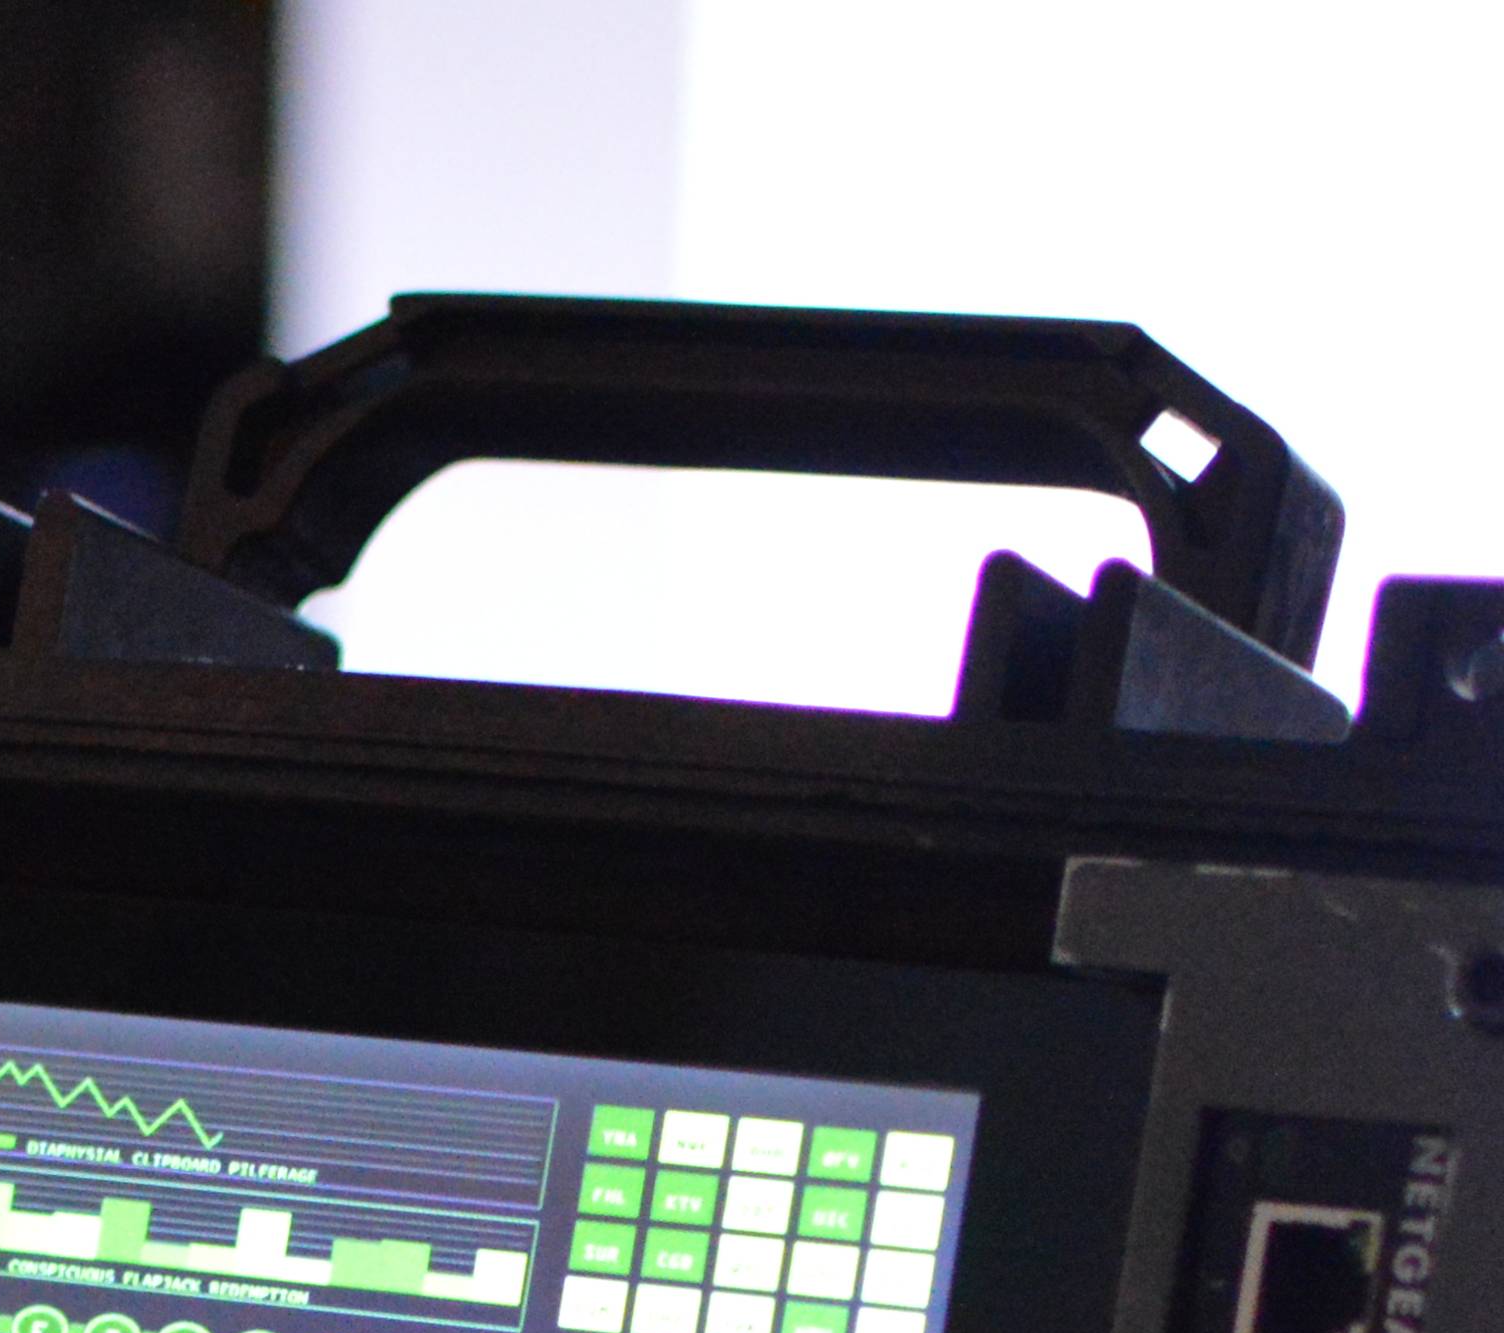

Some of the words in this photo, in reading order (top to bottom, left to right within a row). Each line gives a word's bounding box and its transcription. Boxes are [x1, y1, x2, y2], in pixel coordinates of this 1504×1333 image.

[25, 1138, 121, 1164] DIAPHYSIAL
[130, 1149, 222, 1174] CLIPBOARD
[228, 1159, 319, 1184] PILFERAGE
